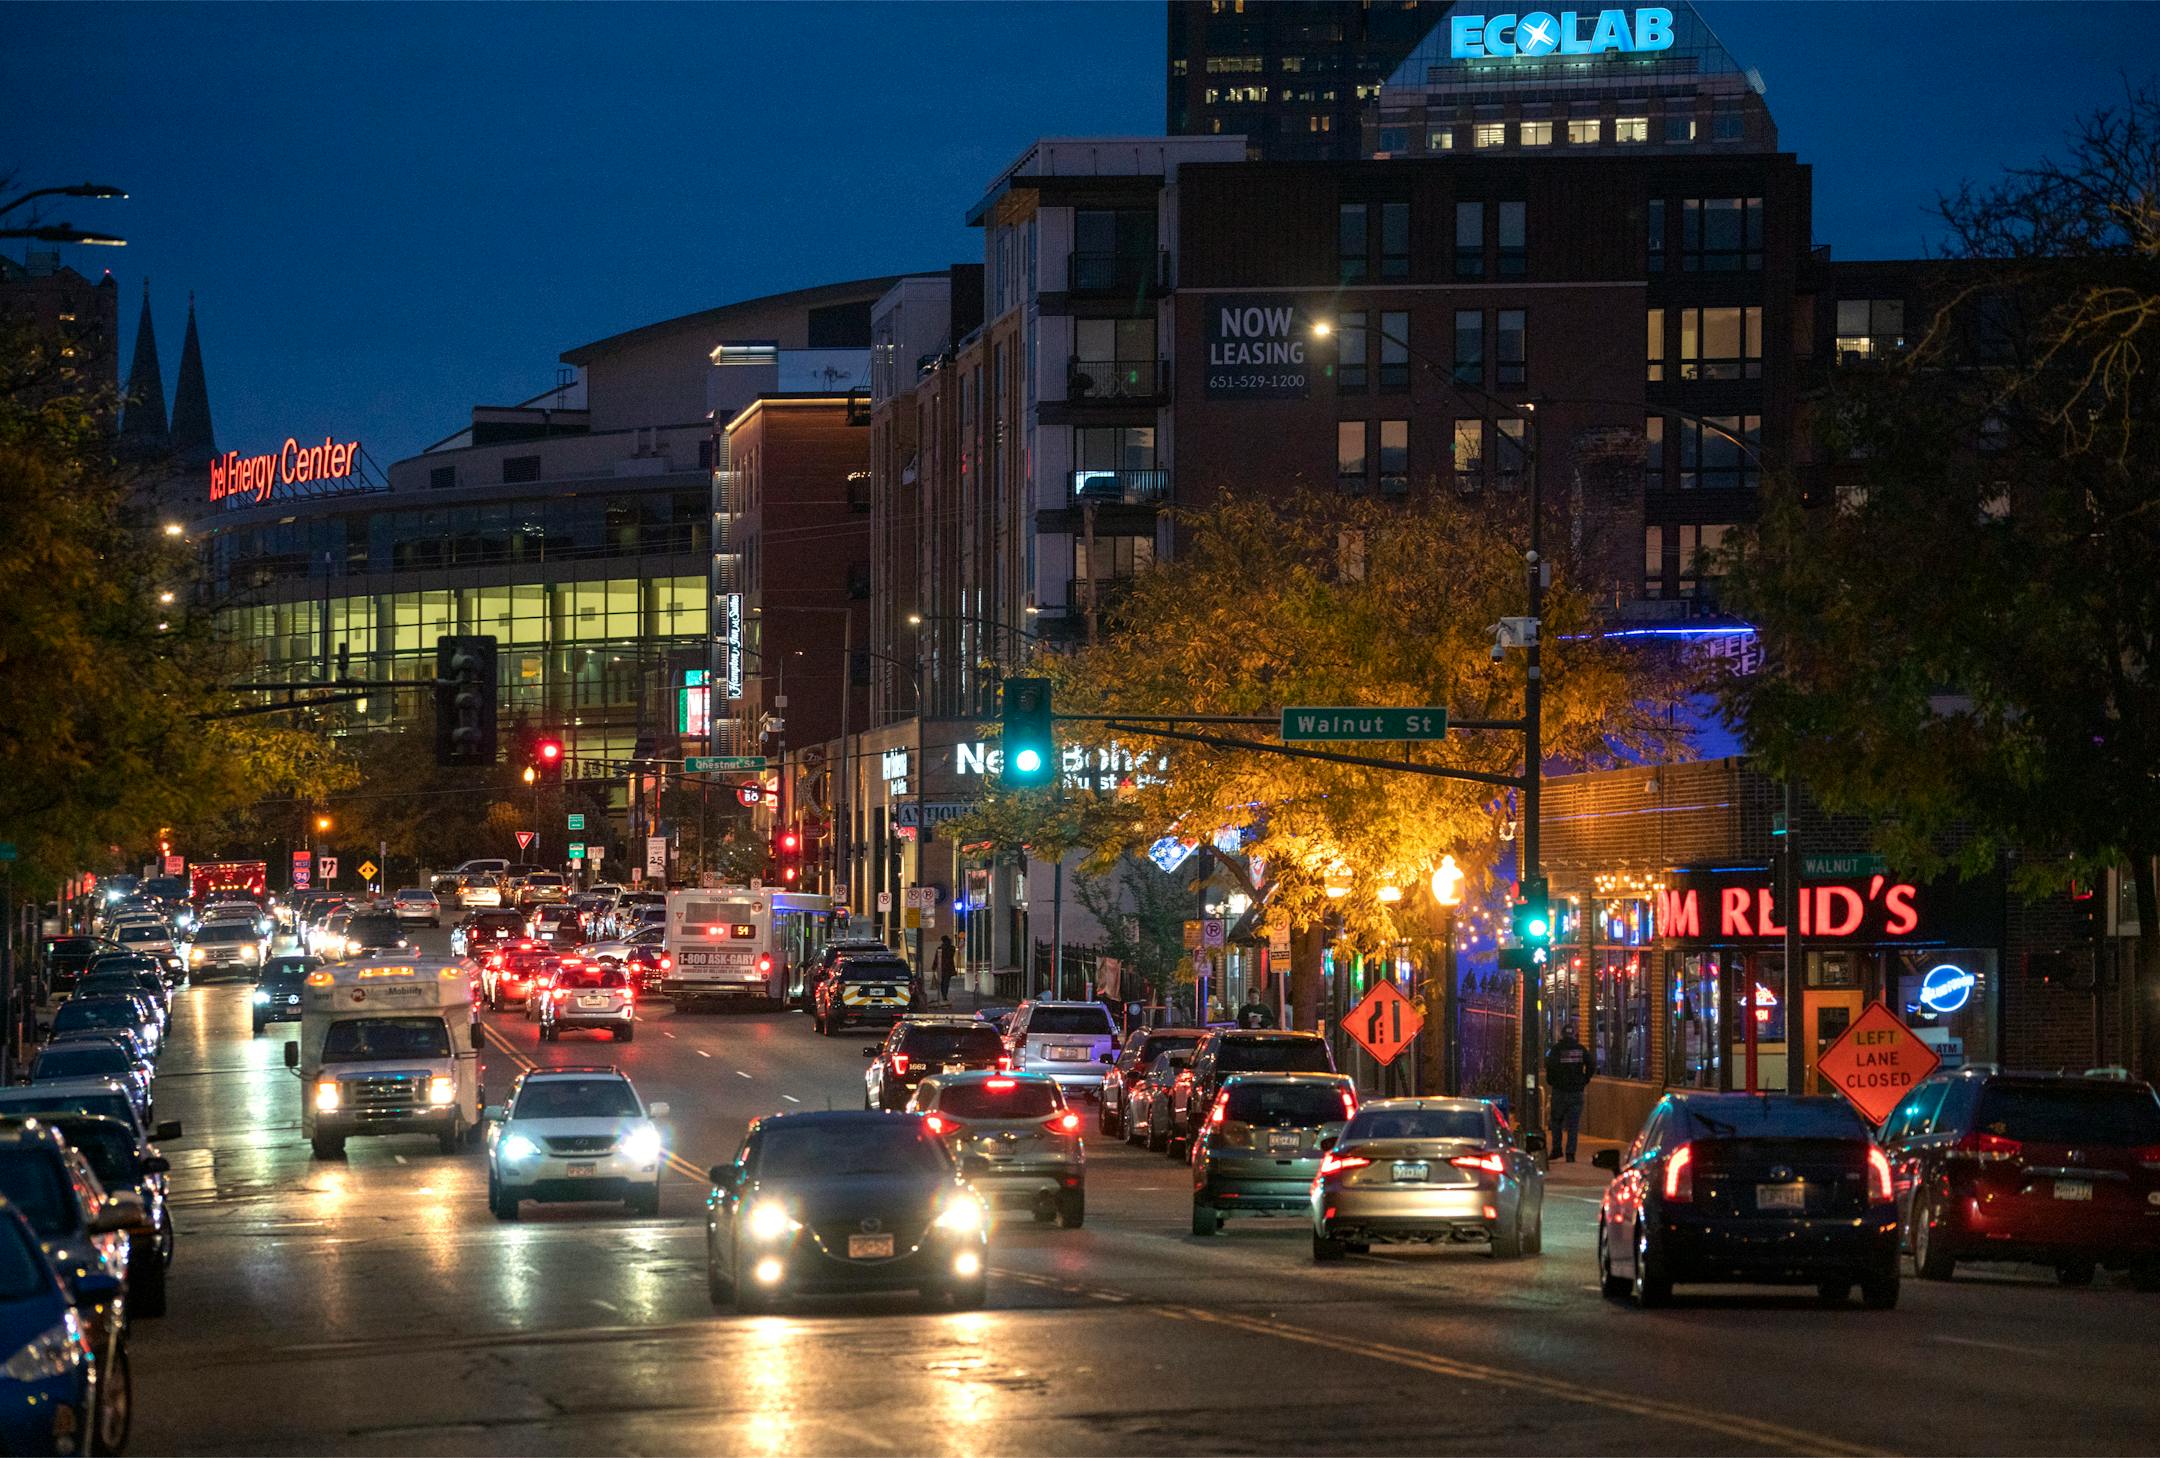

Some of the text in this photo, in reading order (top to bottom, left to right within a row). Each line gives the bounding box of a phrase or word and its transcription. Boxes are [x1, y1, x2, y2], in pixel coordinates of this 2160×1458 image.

[1451, 7, 1675, 59] ECOLAB
[1221, 307, 1294, 337] NOW
[1210, 342, 1304, 365] LEASING
[1209, 374, 1305, 388] 651-529-1200
[228, 450, 278, 503] Energy
[281, 436, 360, 485] Center
[728, 595, 741, 620] Suites
[729, 626, 741, 648] Inn
[728, 649, 741, 696] Hampton
[1297, 715, 1432, 733] Walnut St
[695, 759, 755, 769] Chestnut St
[957, 742, 1005, 775] Ne
[650, 856, 664, 865] 25
[1805, 858, 1859, 874] WALNUT
[296, 872, 307, 882] 94
[737, 925, 749, 936] 54
[680, 953, 755, 965] 1-800 ASK-GARY
[1856, 1030, 1896, 1046] LEFT
[1936, 1043, 1958, 1054] ATM
[909, 1063, 927, 1071] 1662
[1856, 1051, 1900, 1067] LANE
[1846, 1072, 1912, 1089] CLOSED
